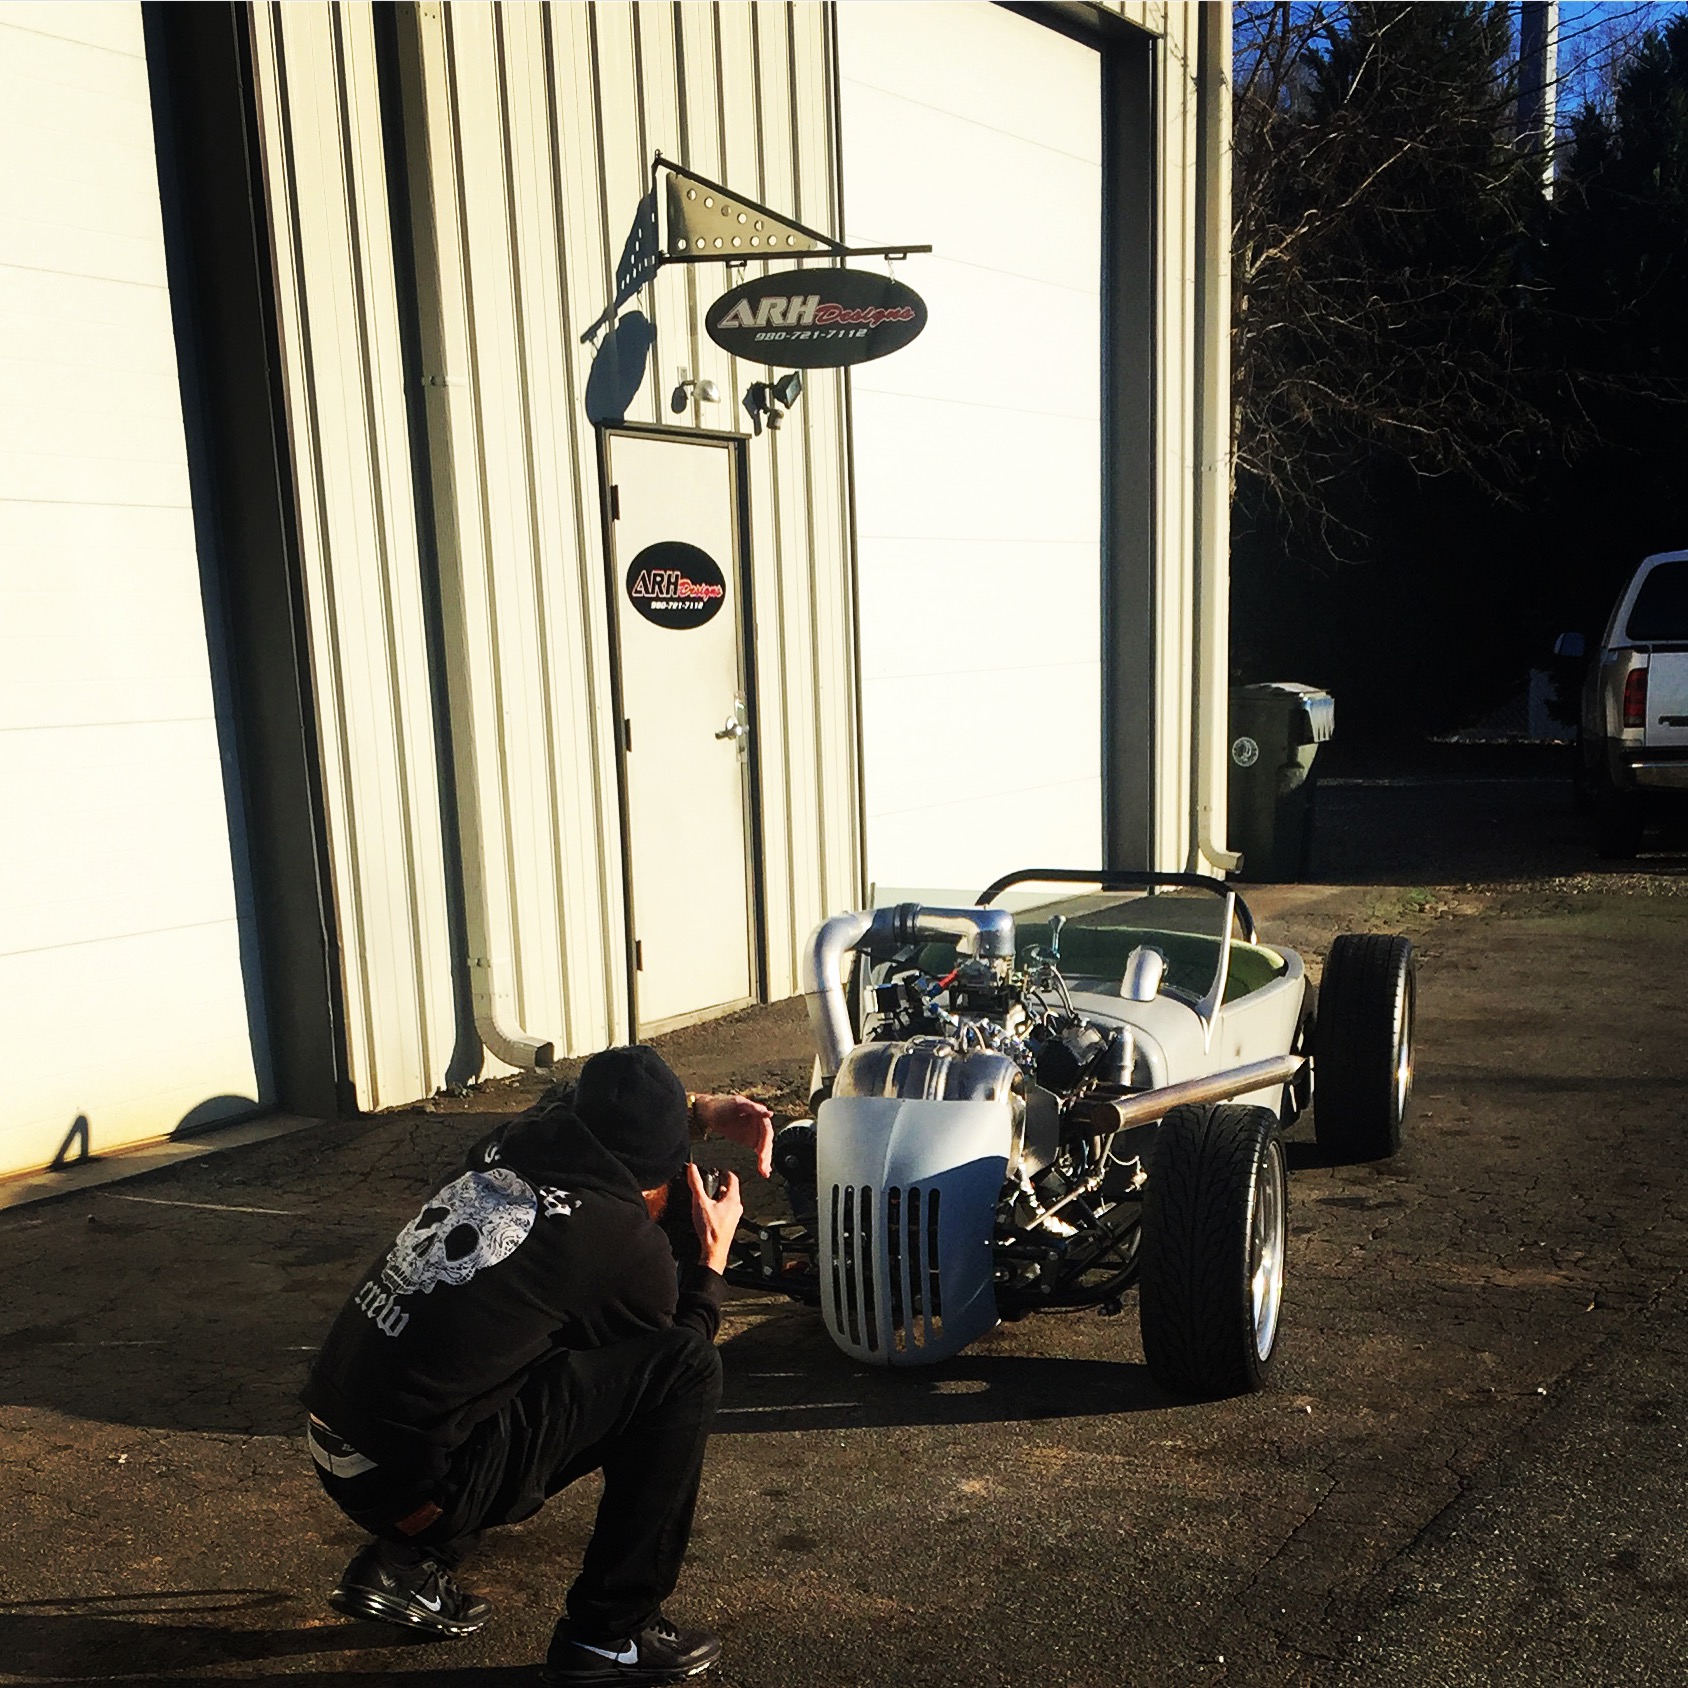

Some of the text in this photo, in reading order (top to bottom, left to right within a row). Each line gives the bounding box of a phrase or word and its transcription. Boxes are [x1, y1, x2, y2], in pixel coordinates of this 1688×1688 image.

[717, 295, 916, 329] ARH Designs
[754, 328, 867, 342] 980-721-7112
[632, 570, 723, 602] ARH Designs
